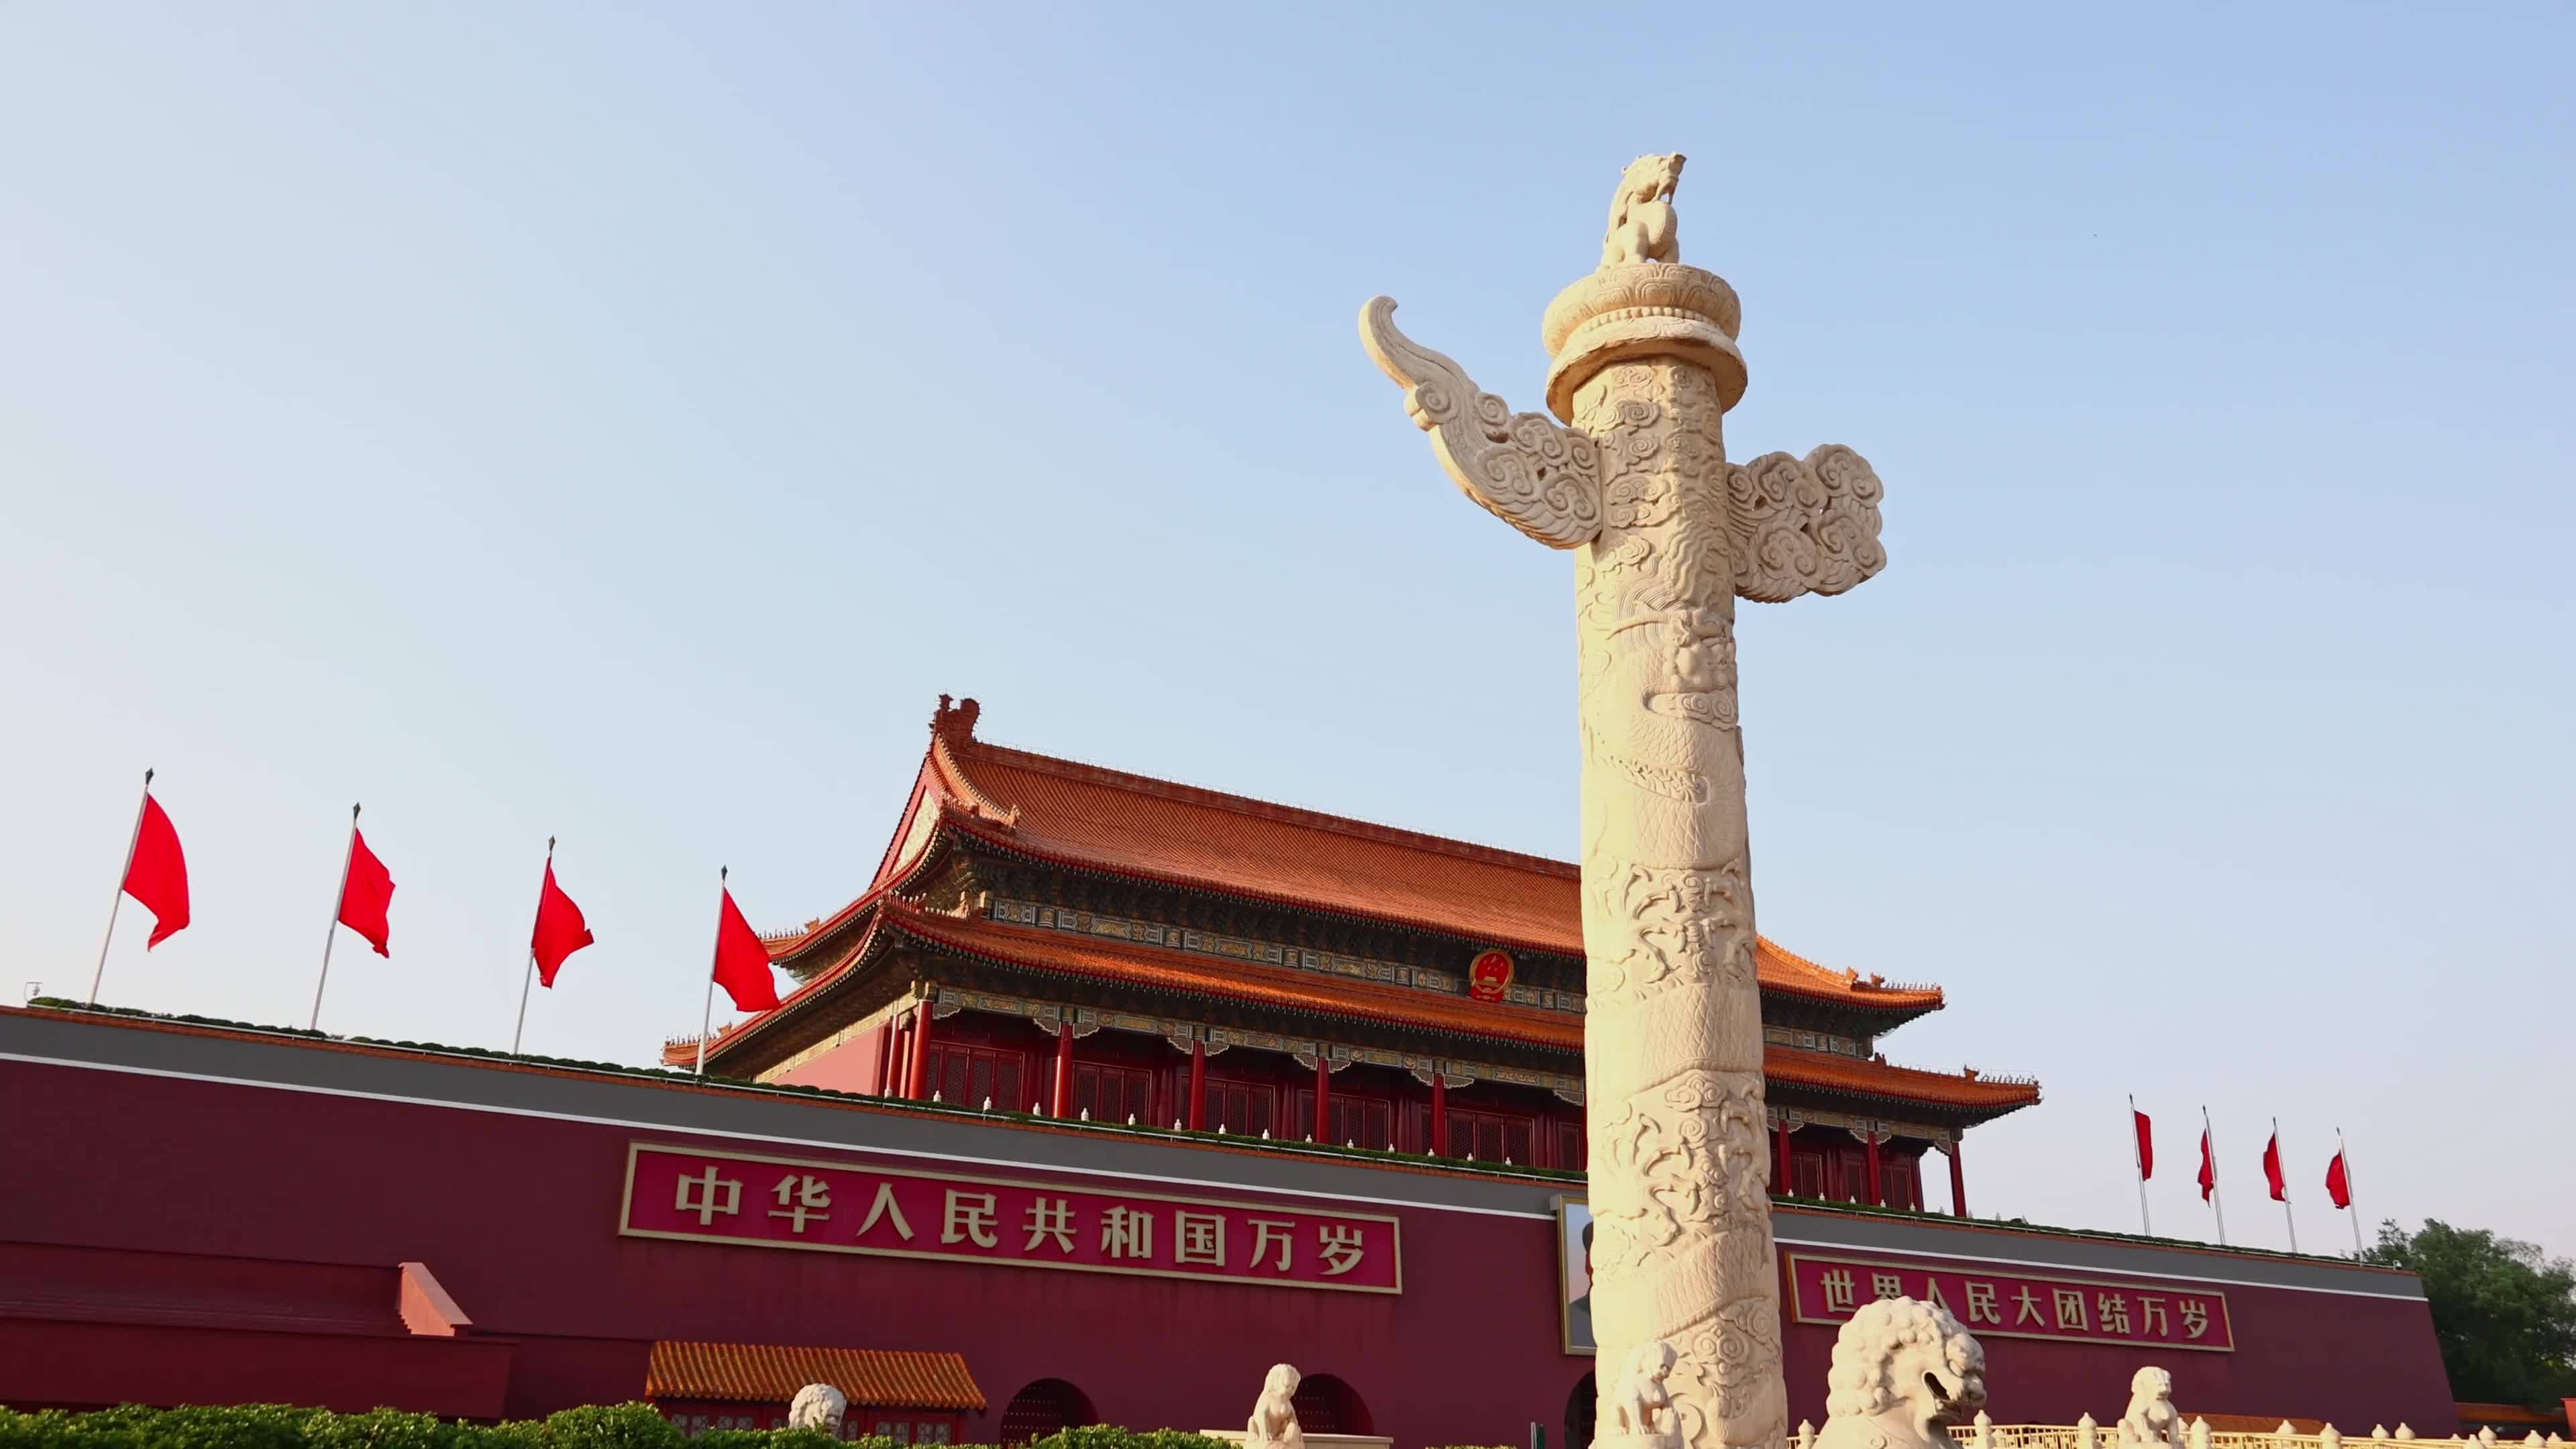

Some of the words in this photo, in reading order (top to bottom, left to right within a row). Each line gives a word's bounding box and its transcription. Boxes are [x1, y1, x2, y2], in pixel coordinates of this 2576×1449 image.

[676, 1166, 1364, 1275] 中华人民共和国万岁
